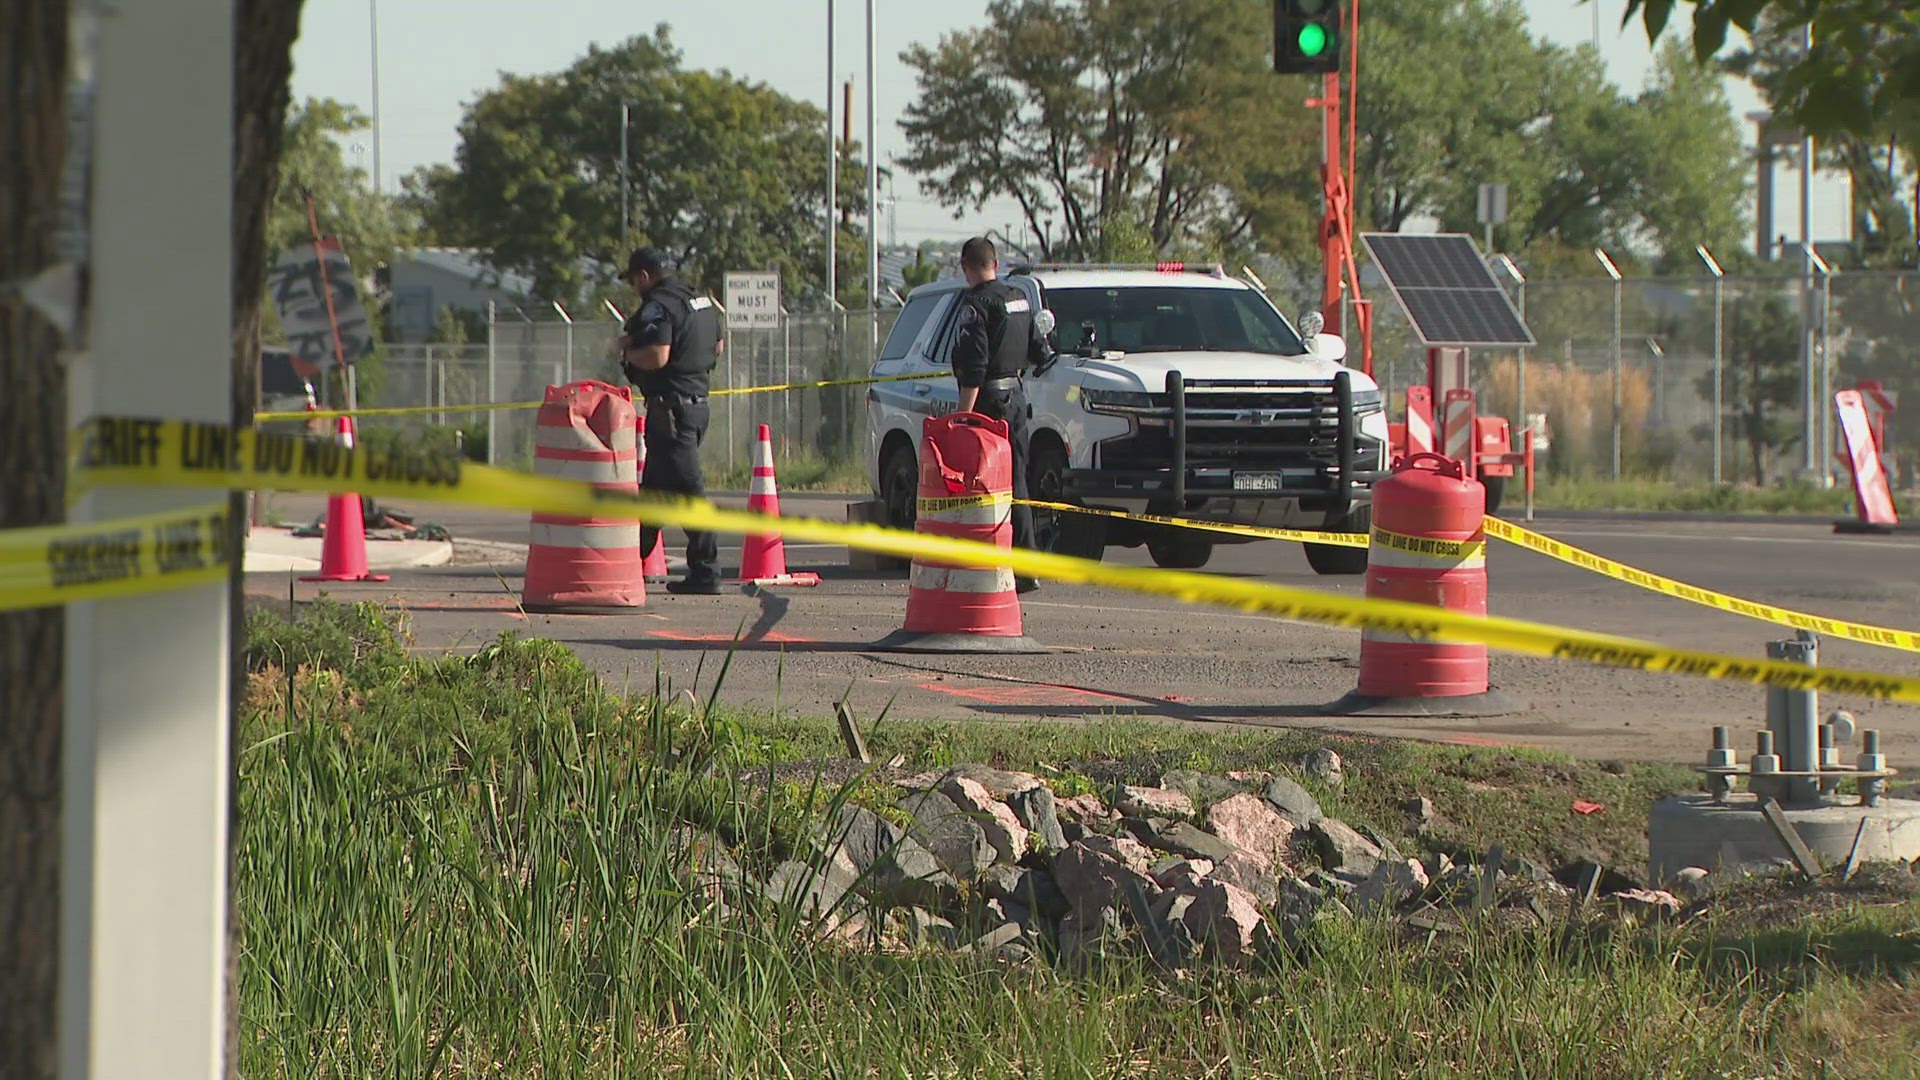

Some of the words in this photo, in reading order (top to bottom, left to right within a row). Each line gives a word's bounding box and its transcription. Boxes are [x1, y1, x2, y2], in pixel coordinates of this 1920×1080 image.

[728, 280, 750, 289] RIGHT
[756, 280, 776, 290] LANE
[738, 295, 767, 308] MUST
[728, 312, 749, 323] TURN
[754, 312, 776, 323] RIGHT
[181, 421, 244, 472] LINE
[253, 431, 293, 474] DO
[939, 499, 947, 511] DO
[1392, 535, 1407, 550] LINE
[1408, 537, 1419, 552] DO
[1420, 539, 1435, 555] NOT
[1436, 541, 1460, 556] CROSS
